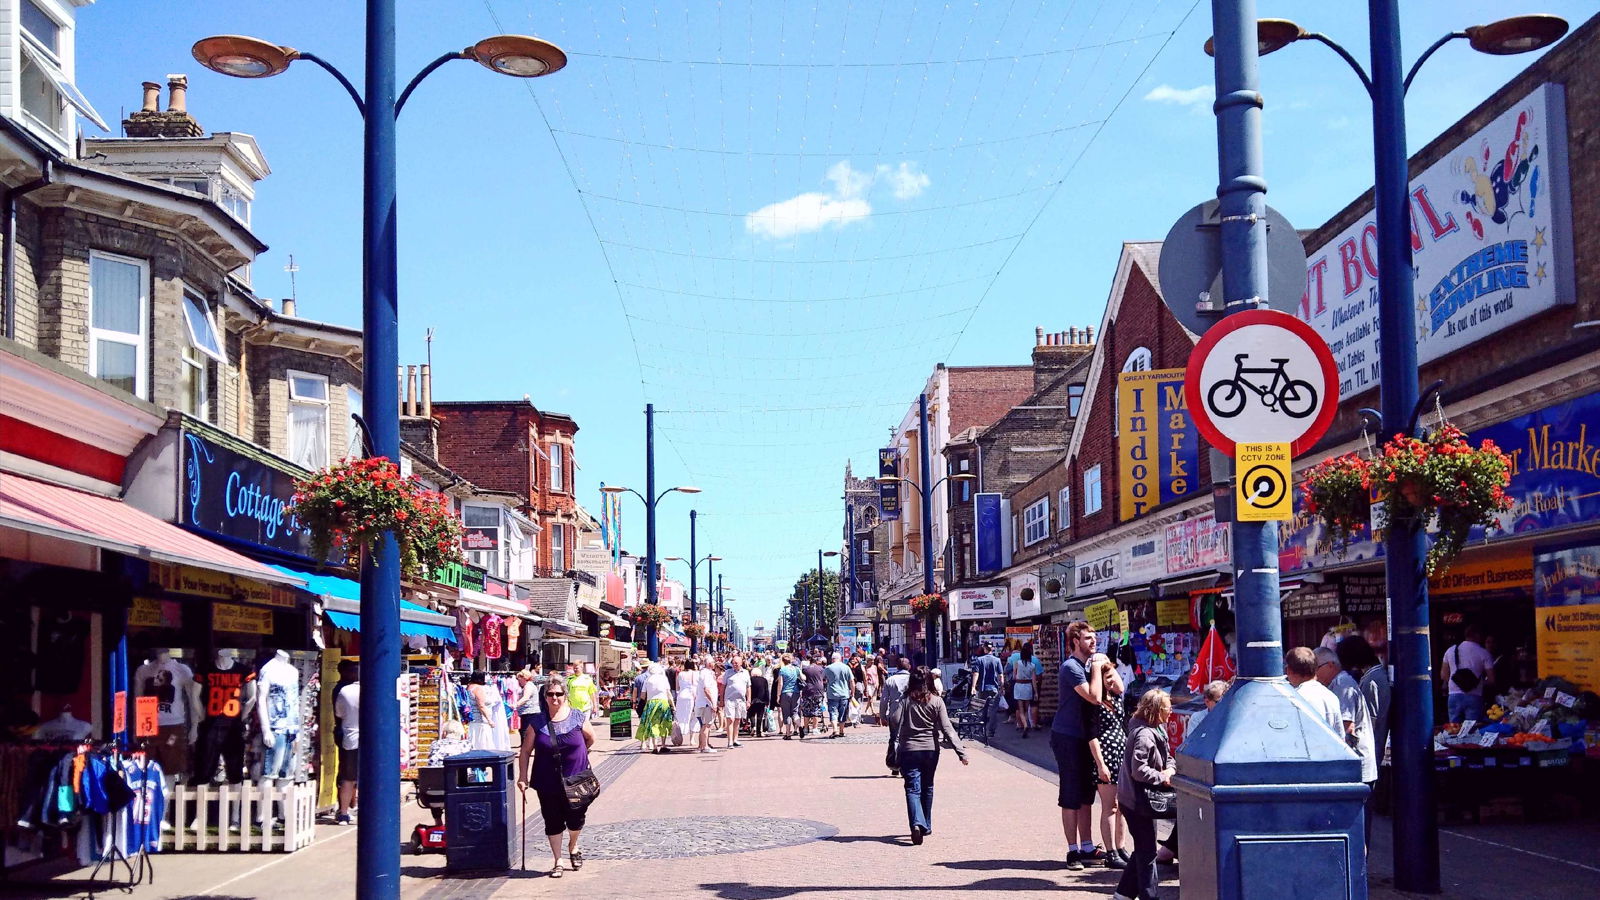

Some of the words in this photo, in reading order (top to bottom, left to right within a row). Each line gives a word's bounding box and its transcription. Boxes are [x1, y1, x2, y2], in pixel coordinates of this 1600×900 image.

[1429, 240, 1529, 315] EXTREME
[1430, 264, 1530, 337] BOWLING
[1457, 314, 1468, 332] out
[1470, 307, 1477, 326] of
[1479, 303, 1492, 323] this
[1494, 291, 1514, 316] world
[1345, 320, 1371, 347] Available
[1347, 349, 1365, 371] Tables
[1355, 367, 1369, 388] TIL
[1130, 388, 1148, 520] Indoor
[226, 471, 284, 539] Cottage
[1080, 558, 1114, 585] BAG
[1452, 572, 1486, 588] Different
[1487, 567, 1533, 583] Businesses
[208, 688, 240, 717] 86
